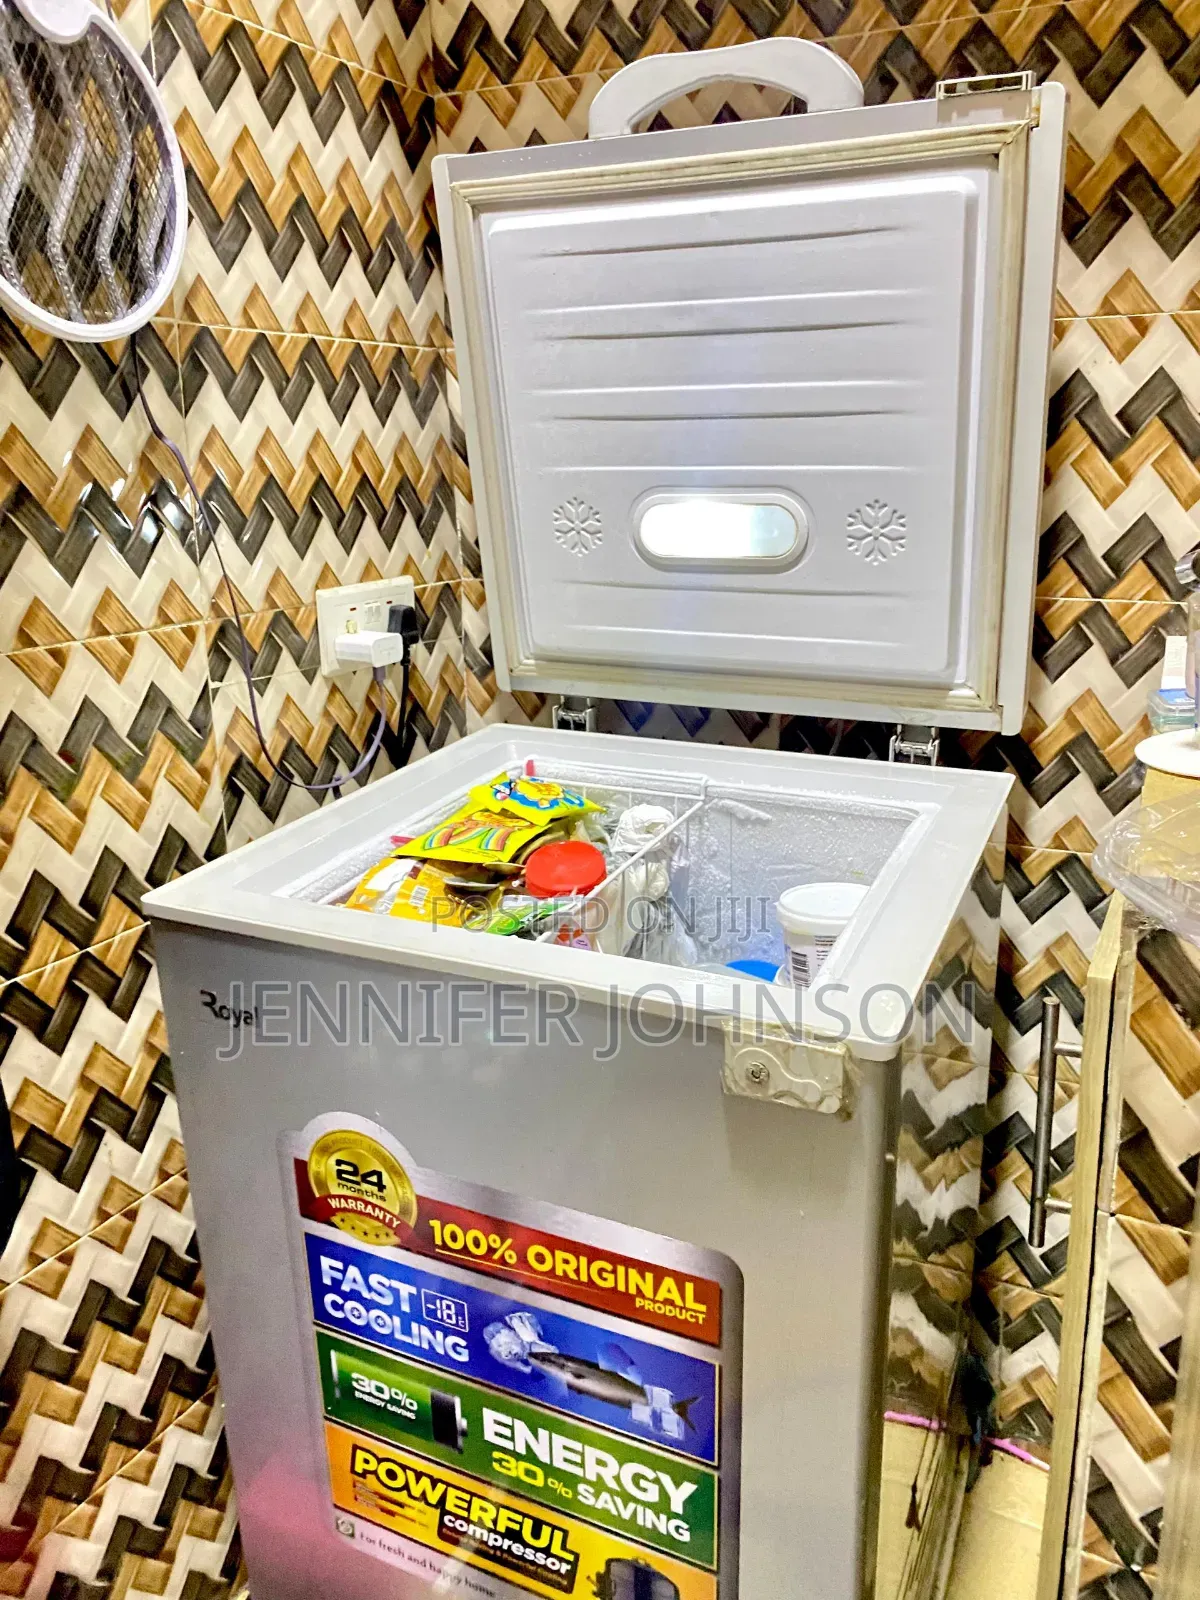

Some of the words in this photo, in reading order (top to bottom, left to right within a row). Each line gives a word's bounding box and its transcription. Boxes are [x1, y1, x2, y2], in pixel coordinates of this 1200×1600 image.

[200, 989, 258, 1028] Royal
[335, 1158, 387, 1193] 24
[337, 1182, 387, 1202] months
[327, 1197, 401, 1228] WARRANTY
[320, 1255, 417, 1313] FAST
[429, 1219, 518, 1264] 100%
[527, 1244, 707, 1312] ORIGINAL
[324, 1293, 470, 1362] COOLING
[635, 1297, 706, 1325] PRODUCT
[351, 1372, 418, 1411] 30%
[482, 1407, 698, 1515] ENERGY
[354, 1448, 575, 1562] POWERFUL
[577, 1483, 691, 1543] SAVING
[379, 1539, 405, 1558] fresh
[408, 1554, 427, 1568] and
[443, 1514, 572, 1575] compressor
